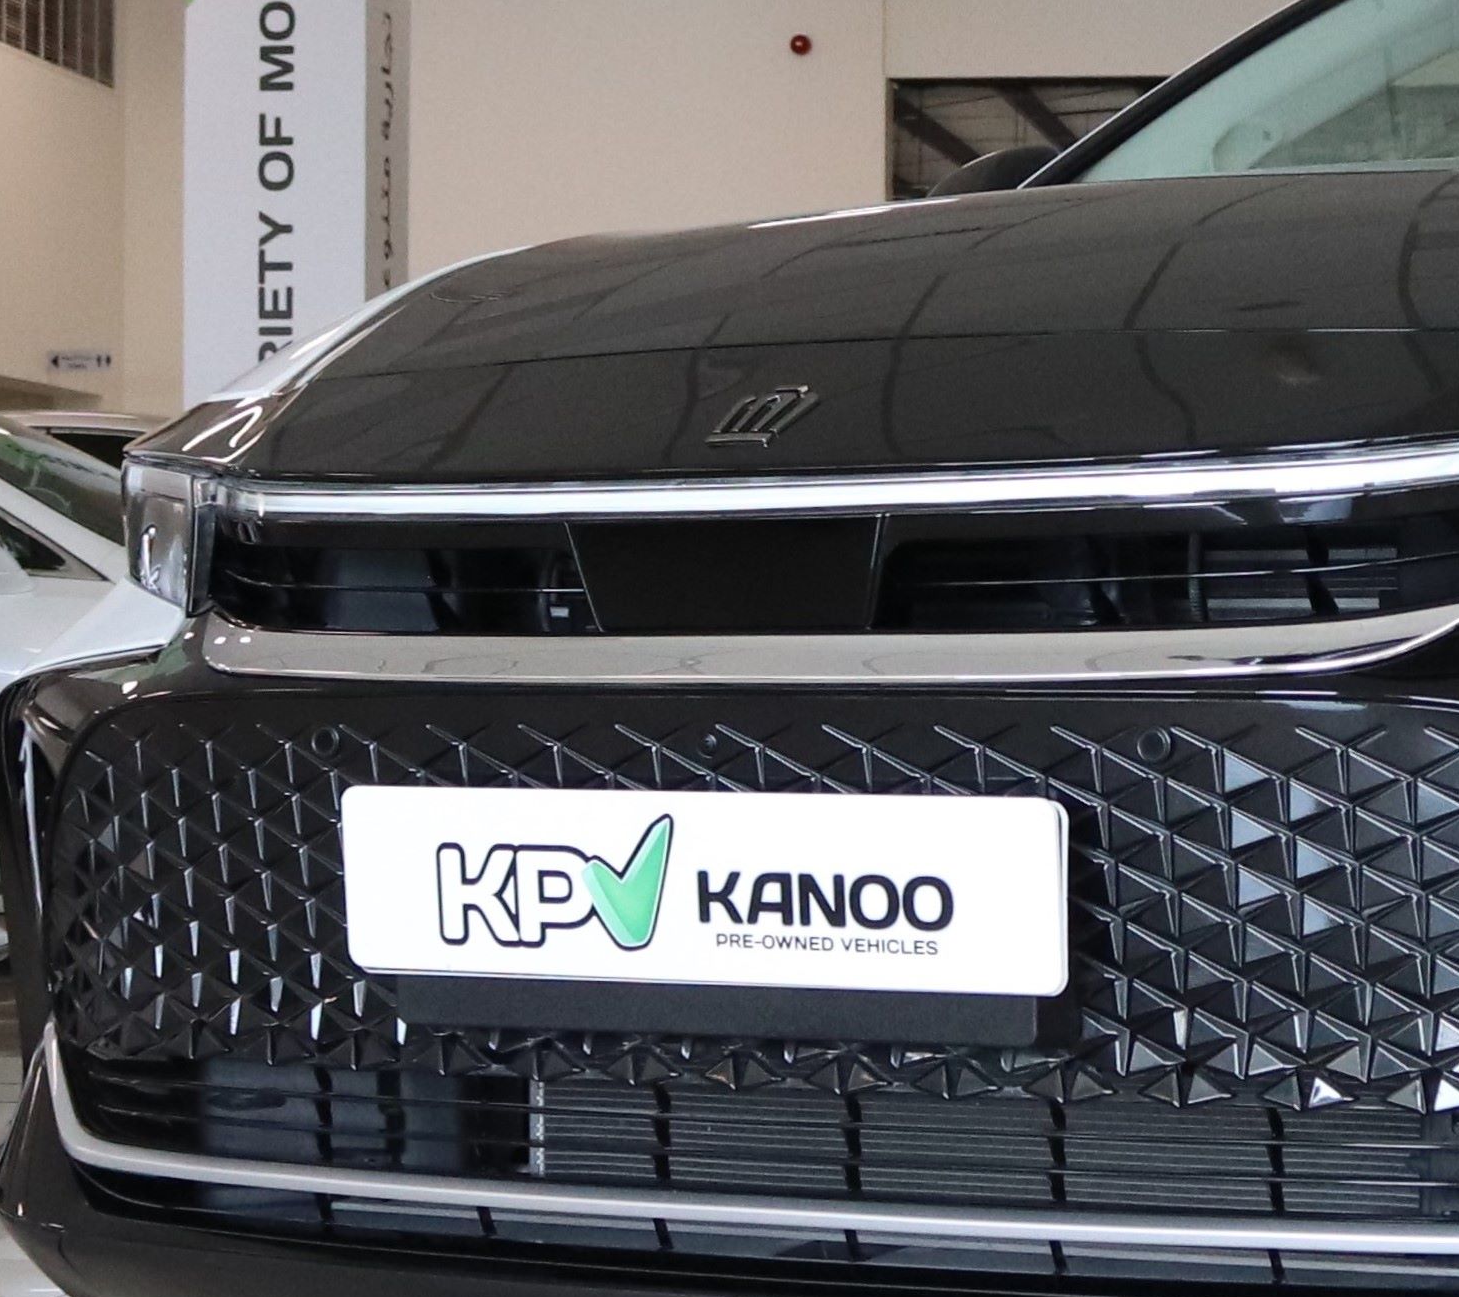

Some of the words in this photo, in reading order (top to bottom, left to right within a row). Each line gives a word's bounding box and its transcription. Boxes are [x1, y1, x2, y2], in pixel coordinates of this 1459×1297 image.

[256, 112, 296, 193] OF
[697, 869, 955, 933] KANOO
[716, 933, 835, 953] PRE-OWNED
[843, 937, 939, 956] VEHICLES
